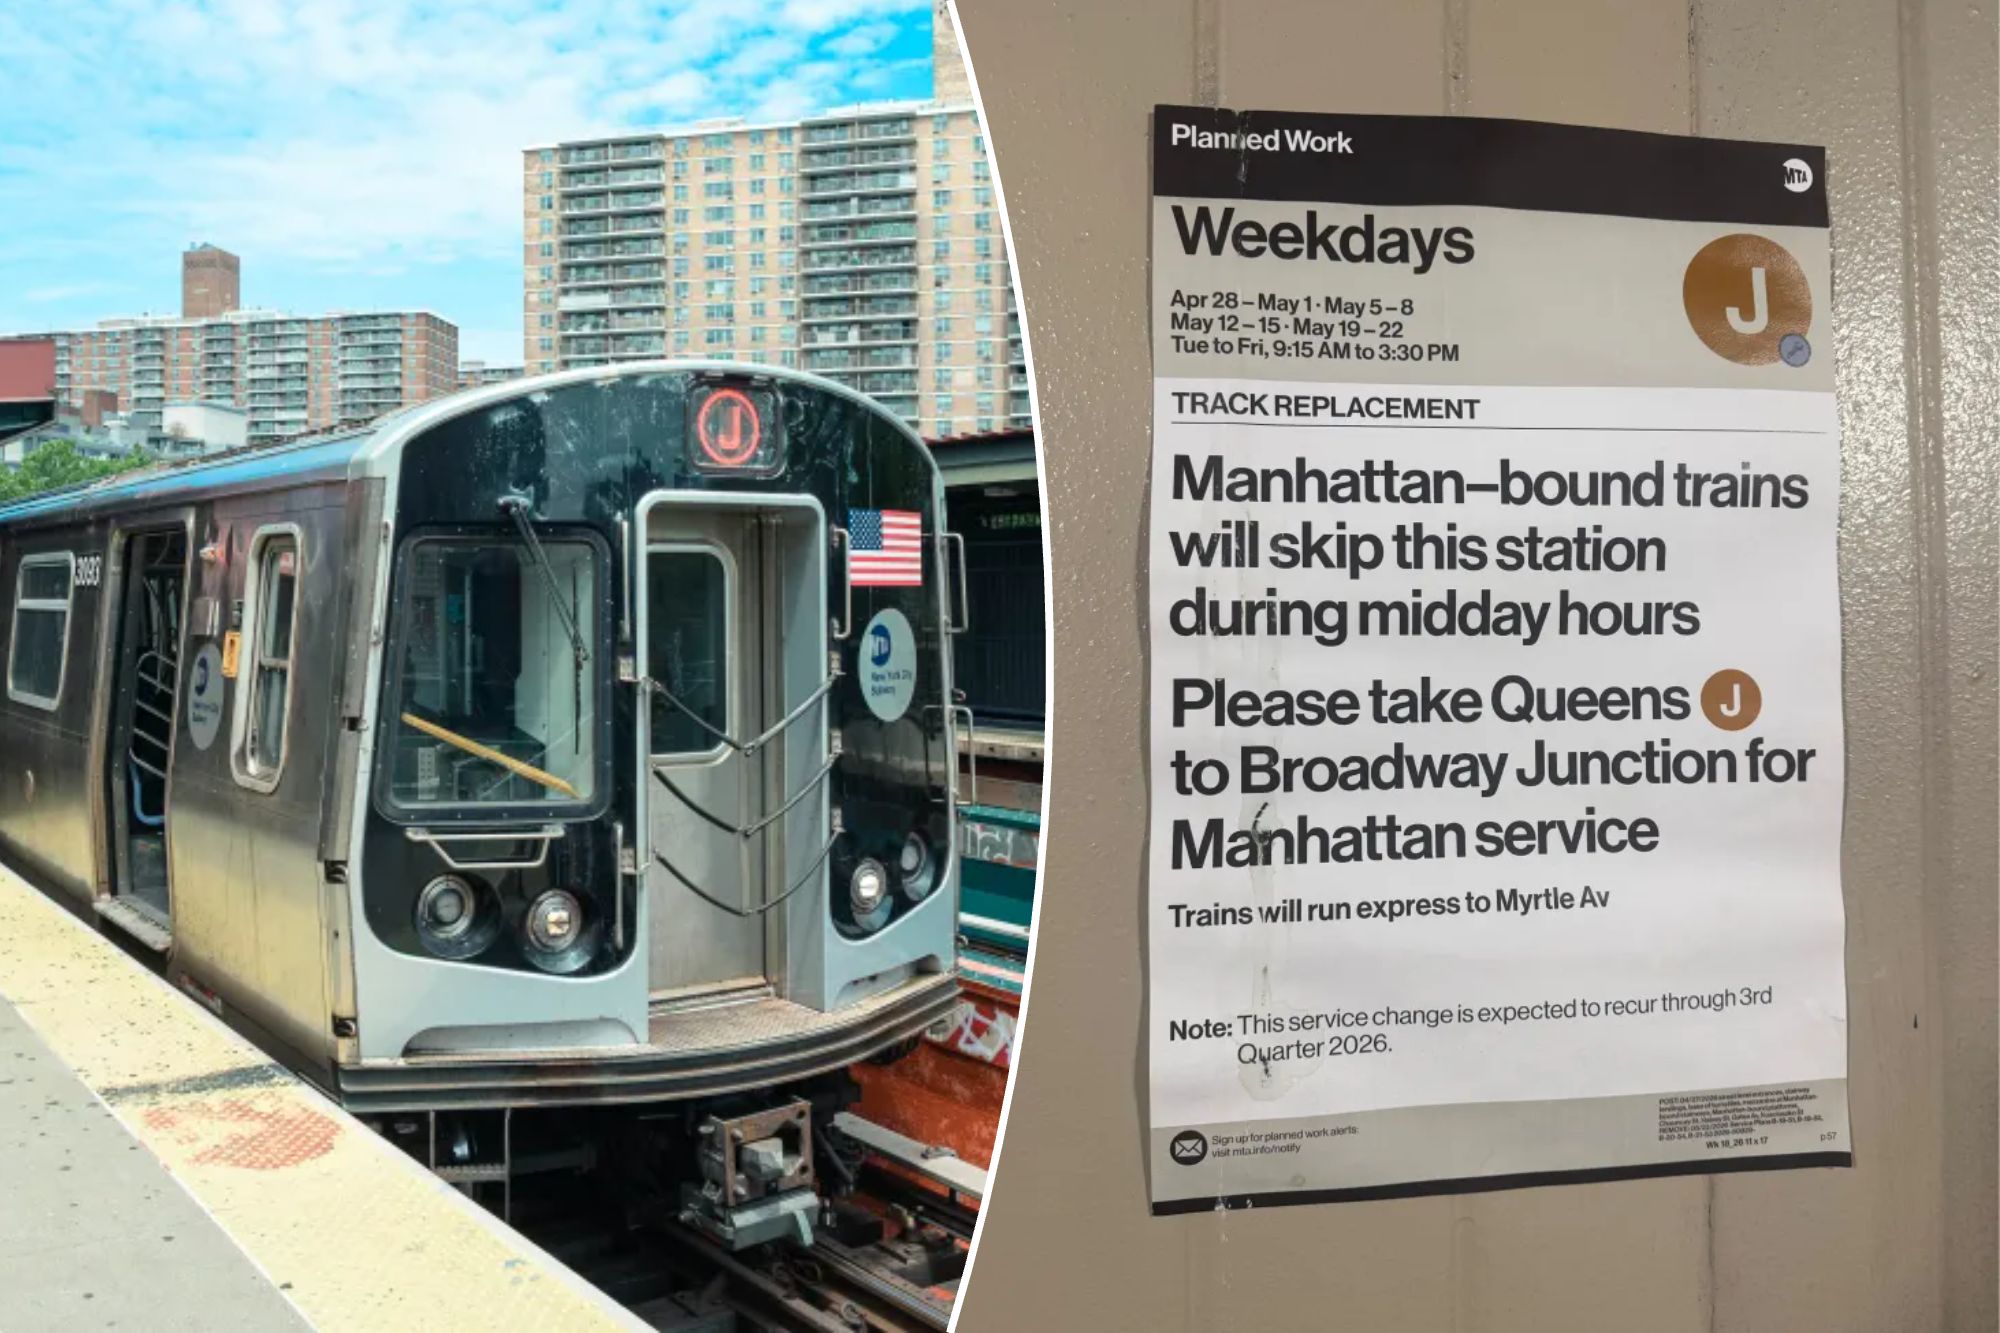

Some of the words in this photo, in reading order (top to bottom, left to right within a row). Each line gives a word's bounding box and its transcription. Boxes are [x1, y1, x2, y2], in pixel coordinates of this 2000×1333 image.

[1172, 124, 1279, 151] Planned
[1284, 129, 1354, 154] Work
[1172, 205, 1474, 275] Weekdays
[1171, 290, 1208, 311] Apr
[1725, 267, 1769, 334] J
[1172, 313, 1214, 334] May
[1171, 336, 1209, 353] Tue
[1213, 337, 1233, 354] to
[1238, 337, 1269, 359] Fri,
[1273, 340, 1314, 358] 9:15
[1318, 341, 1350, 359] AM
[1355, 344, 1374, 360] to
[1379, 344, 1423, 361] 3:30
[1428, 344, 1459, 361] PM
[1172, 392, 1269, 416] TRACK
[1275, 395, 1480, 419] REPLACEMENT
[718, 406, 740, 450] J
[1673, 462, 1809, 509] trains
[1169, 520, 1259, 568] will
[1269, 521, 1384, 580] skip
[1392, 522, 1488, 571] this
[1496, 525, 1666, 572] station
[1170, 587, 1348, 647] during
[1359, 589, 1551, 646] midday
[1559, 589, 1700, 636] hours
[1173, 678, 1360, 727] Please
[1368, 676, 1483, 724] take
[1491, 675, 1691, 723] Queens
[1719, 684, 1741, 716] J
[1171, 751, 1229, 796] to
[1241, 742, 1508, 797] Broadway
[1516, 738, 1737, 786] Junction
[1745, 737, 1816, 783] for
[1171, 815, 1466, 870] Manhattan
[1475, 806, 1659, 857] service
[1168, 902, 1253, 927] Trains
[1258, 899, 1302, 923] will
[1308, 902, 1351, 921] run
[1356, 897, 1460, 922] express
[1465, 892, 1491, 913] to
[1496, 887, 1574, 916] Myrtle
[1580, 886, 1609, 908] Av
[1170, 1019, 1232, 1040] Note:
[1237, 1013, 1284, 1035] This
[1289, 1009, 1368, 1031] service
[1372, 1006, 1453, 1028] change
[1458, 1004, 1474, 1023] is
[1478, 999, 1576, 1025] expected
[1581, 999, 1600, 1017] to
[1605, 999, 1657, 1016] recur
[1662, 989, 1736, 1012] through
[1740, 986, 1772, 1005] 3rd
[1237, 1041, 1324, 1064] Quarter
[1328, 1034, 1392, 1056] 2026.
[1212, 1135, 1234, 1146] Sign
[1236, 1135, 1249, 1144] up
[1250, 1133, 1263, 1142] for
[1265, 1129, 1303, 1142] planned
[1305, 1128, 1328, 1138] work
[1212, 1146, 1230, 1157] visit
